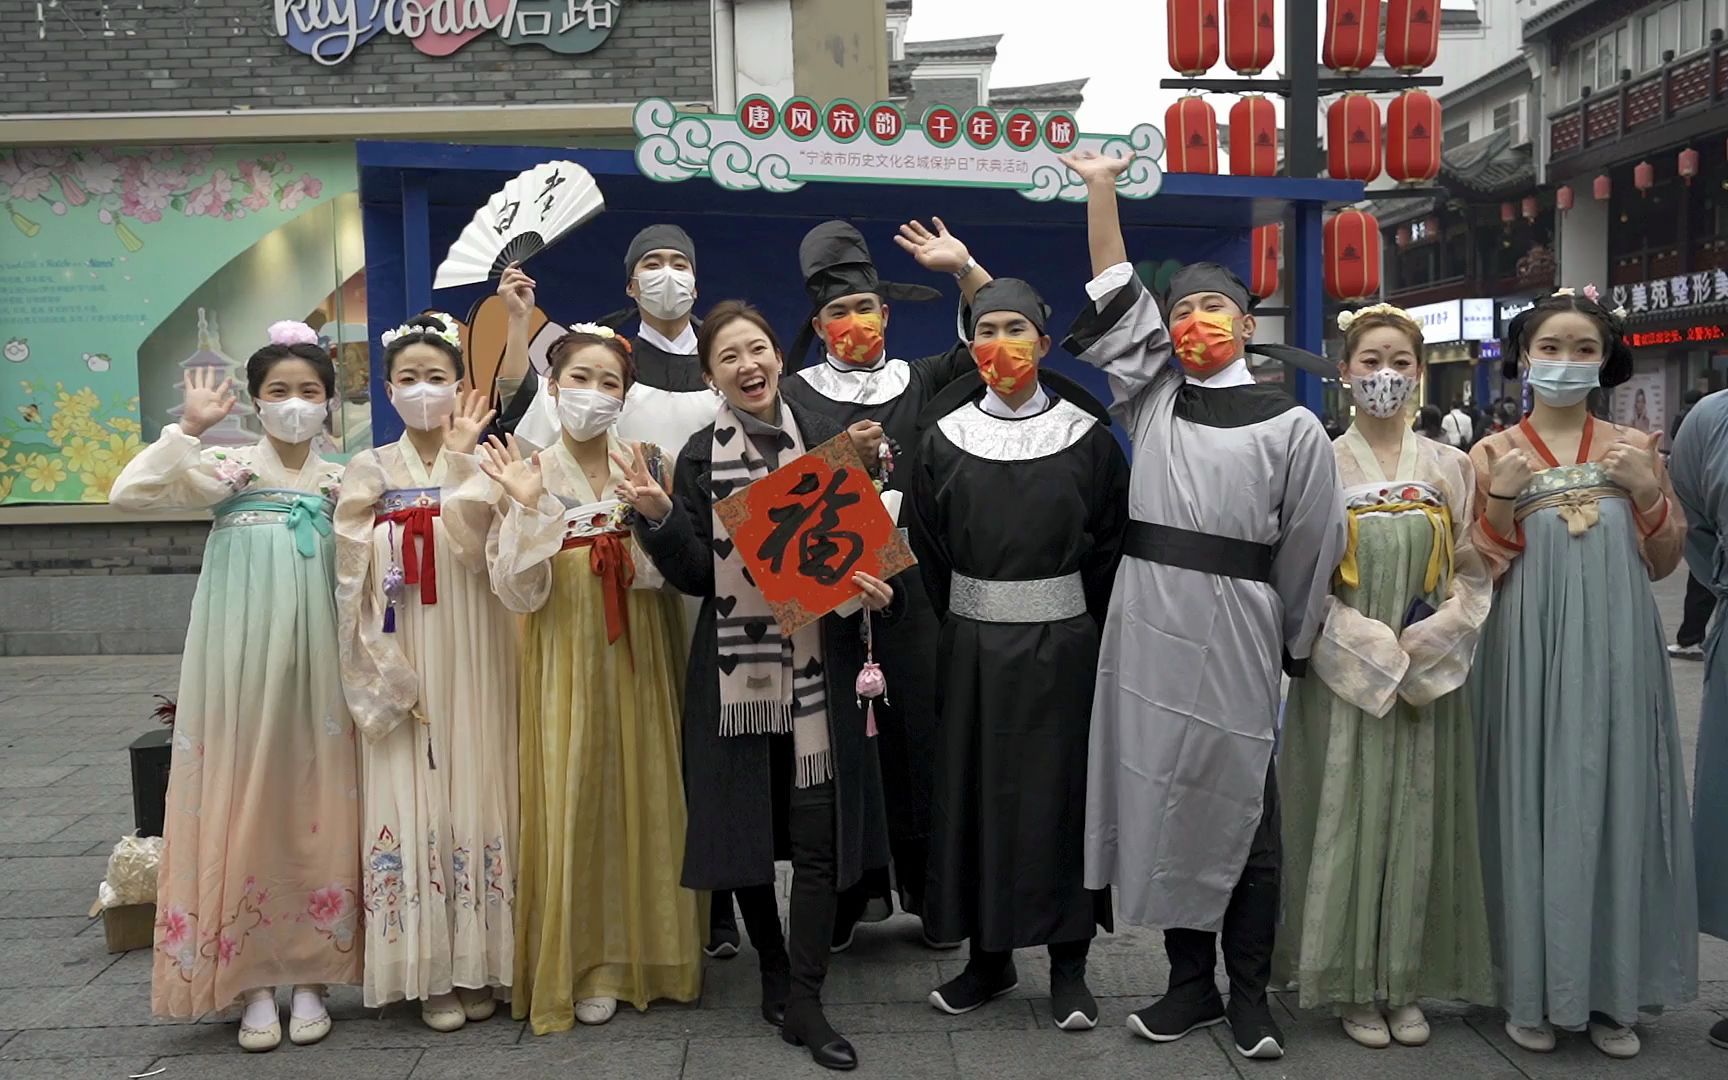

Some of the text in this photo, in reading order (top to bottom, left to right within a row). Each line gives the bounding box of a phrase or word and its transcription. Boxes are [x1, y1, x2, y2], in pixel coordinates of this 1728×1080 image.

[748, 105, 1071, 144] 唐风宋韵 千年子城
[757, 468, 864, 585] 福
